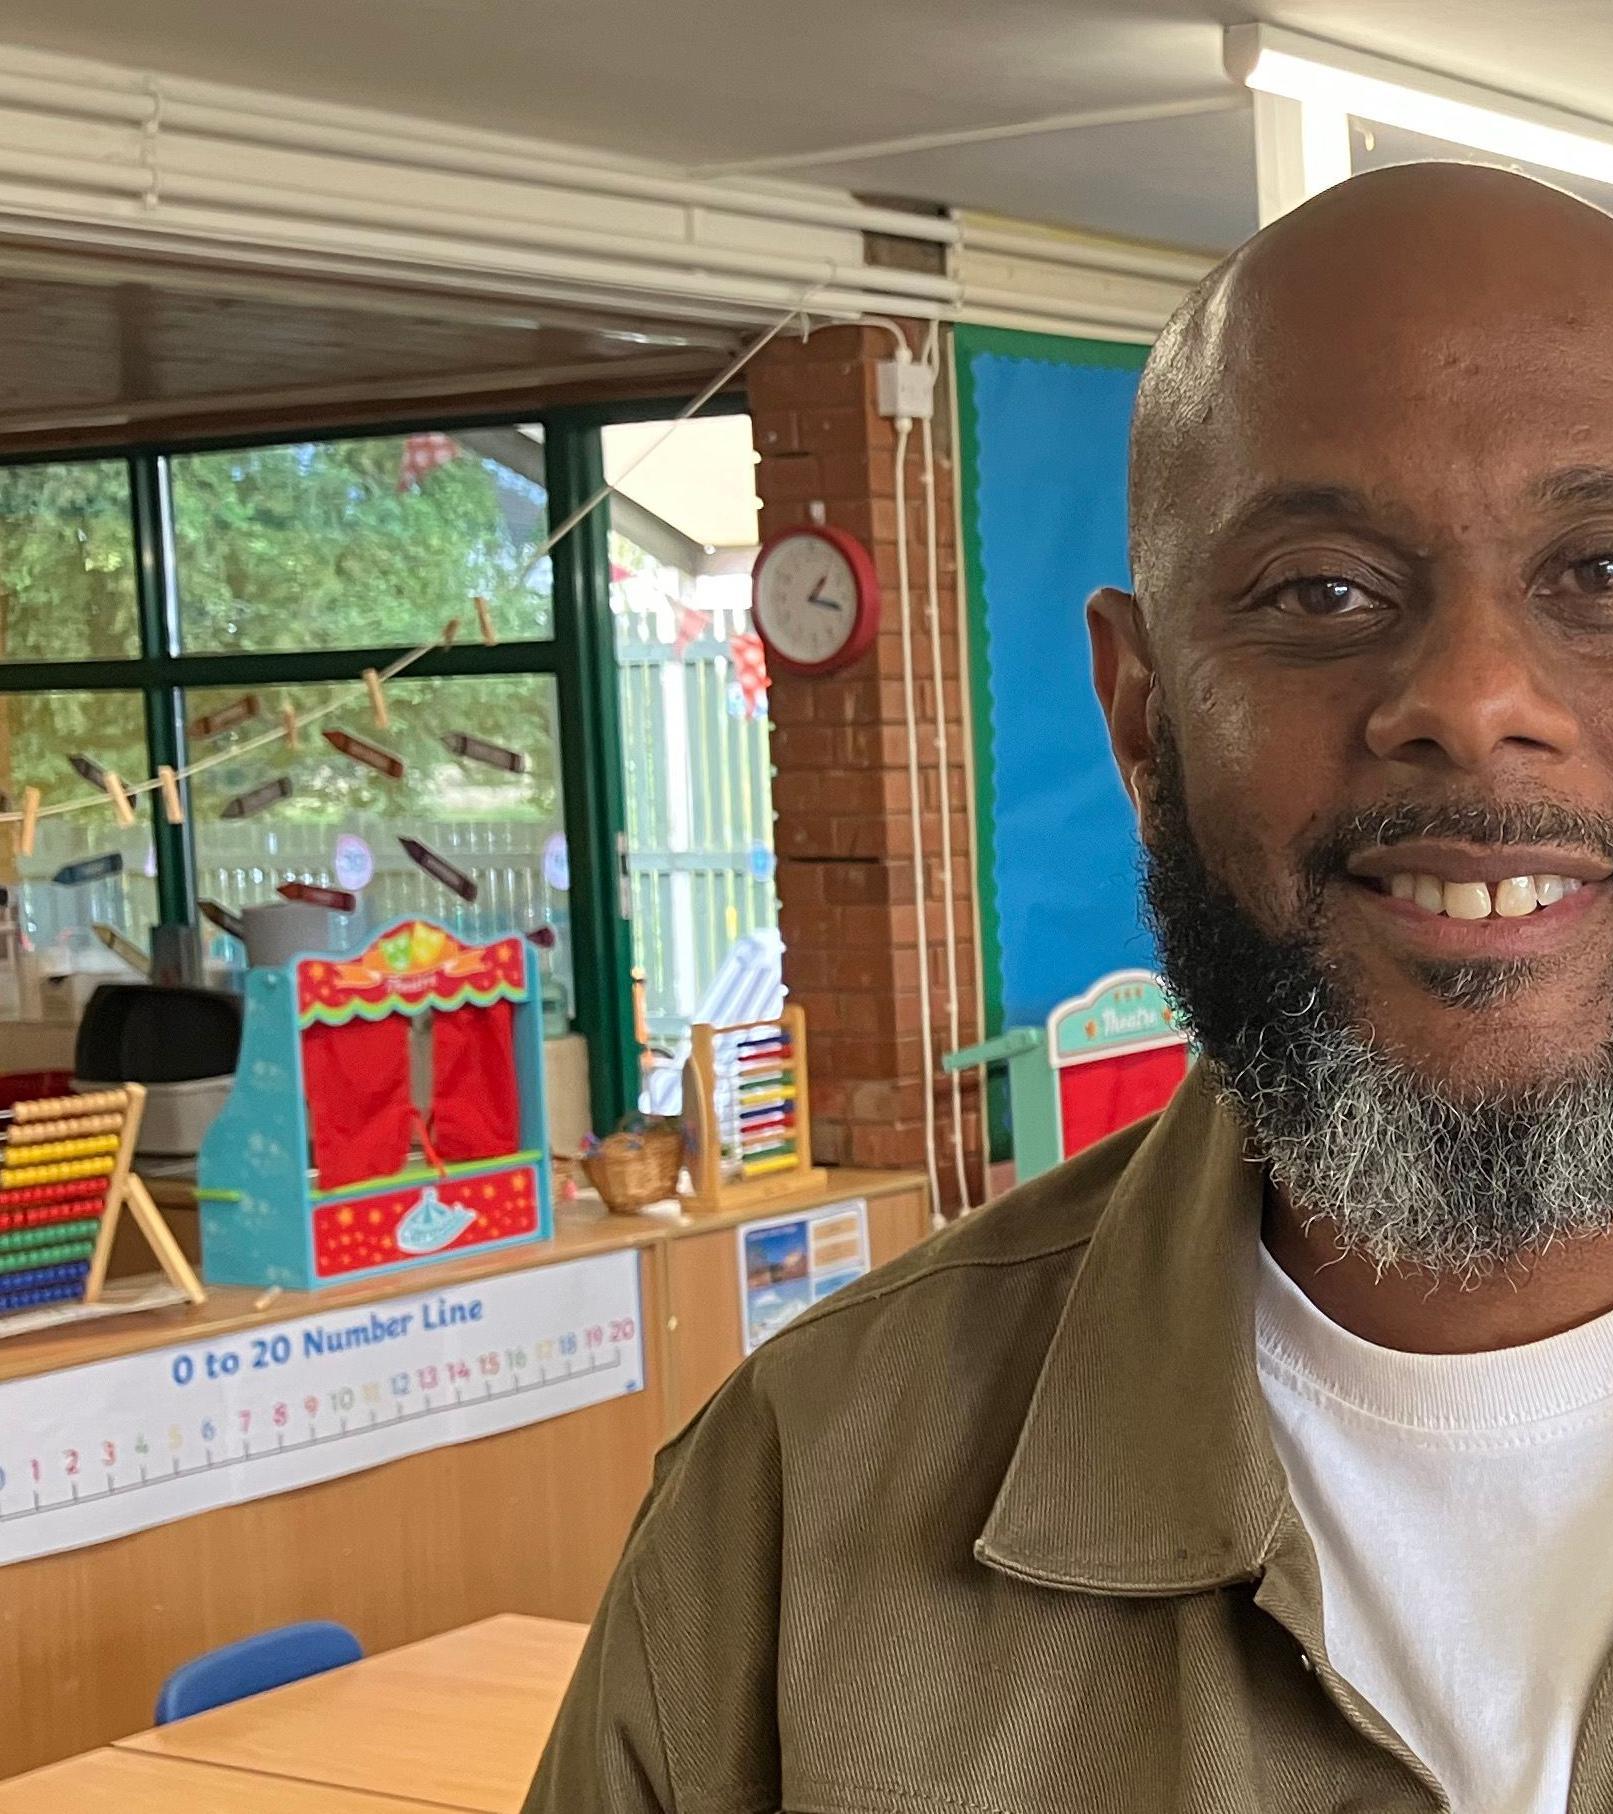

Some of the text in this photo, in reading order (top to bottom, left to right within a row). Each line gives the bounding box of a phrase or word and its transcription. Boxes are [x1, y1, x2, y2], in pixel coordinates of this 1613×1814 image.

[31, 1459, 41, 1482] 1
[65, 1449, 80, 1475] 2
[102, 1440, 117, 1467] 3
[201, 1416, 216, 1441] 6
[239, 1408, 252, 1433] 7
[331, 1386, 354, 1411] 10
[608, 1317, 635, 1343] 20
[172, 1298, 484, 1386] 0 to 20 Number Line
